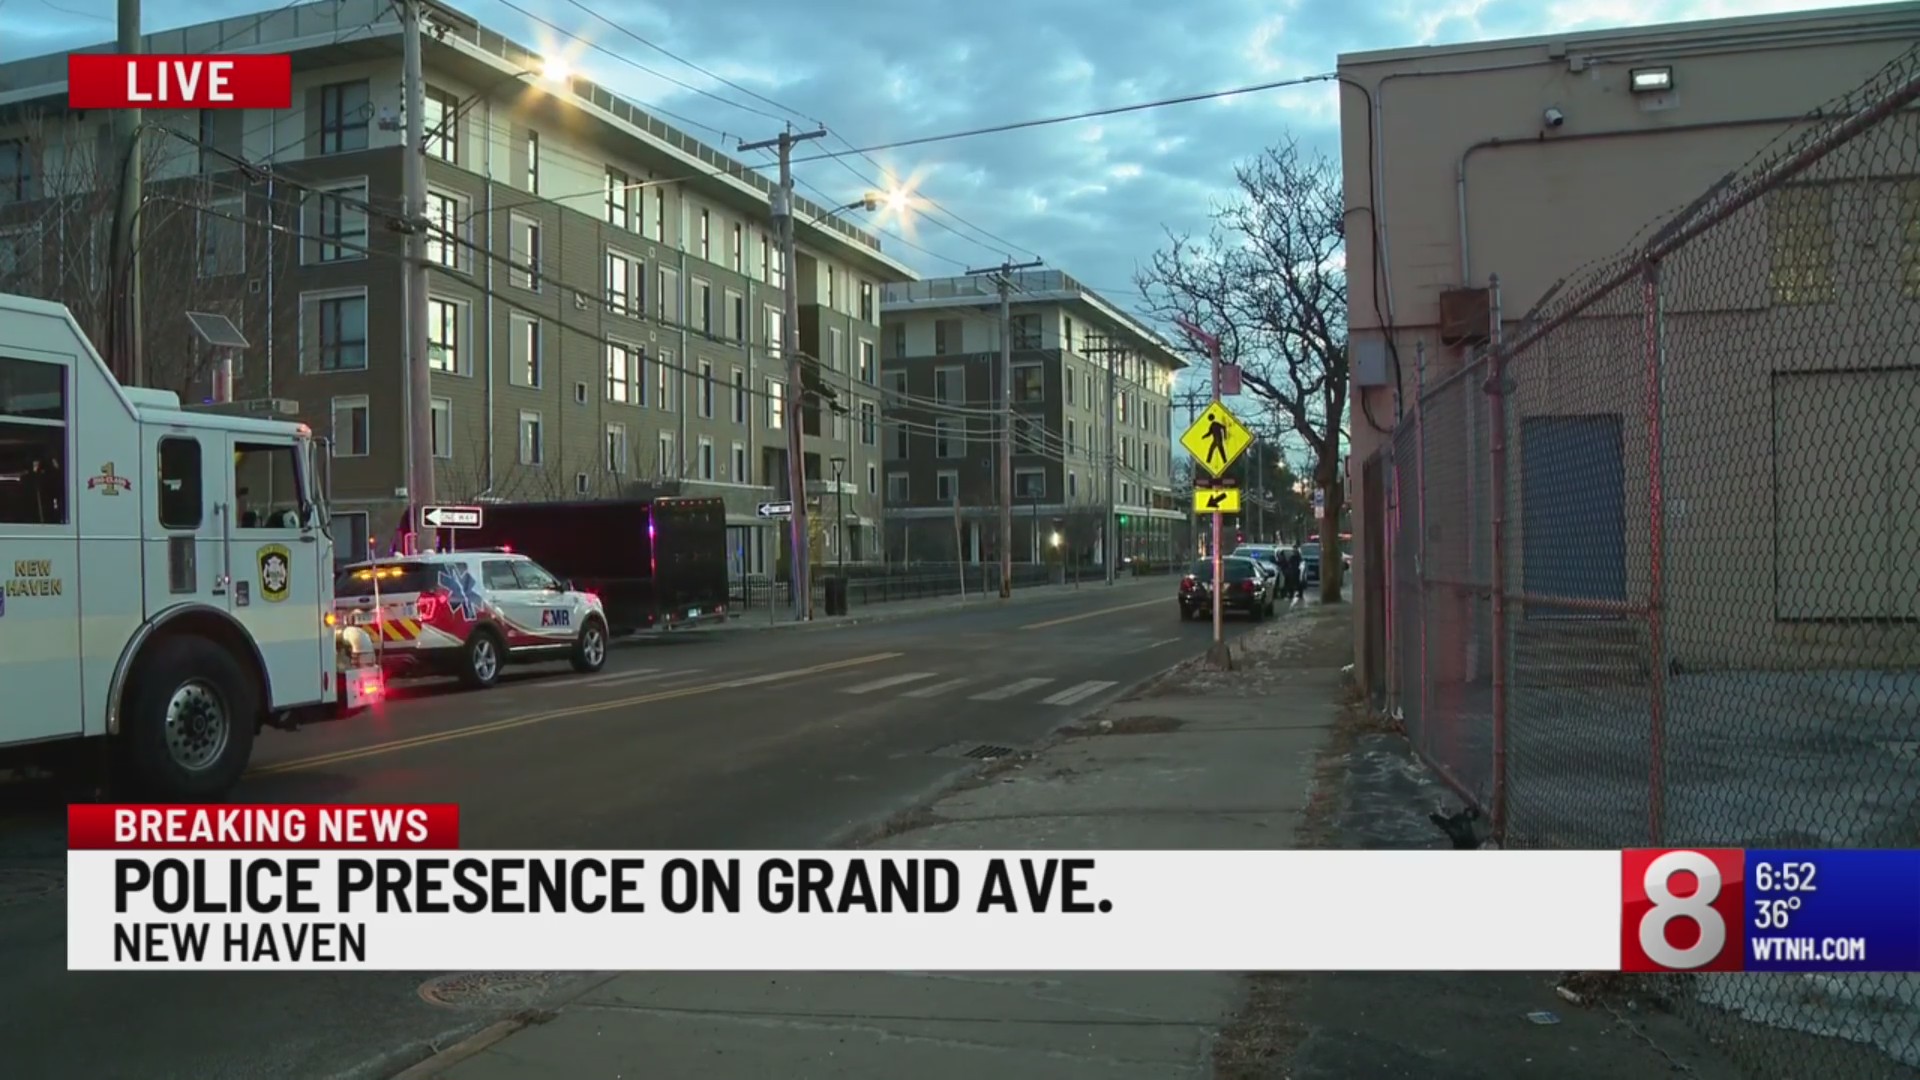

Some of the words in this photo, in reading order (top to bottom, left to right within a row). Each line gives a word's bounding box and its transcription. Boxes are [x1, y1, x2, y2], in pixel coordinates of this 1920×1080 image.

[14, 560, 51, 577] NEW
[6, 579, 62, 596] HAVEN
[542, 609, 570, 626] AMR
